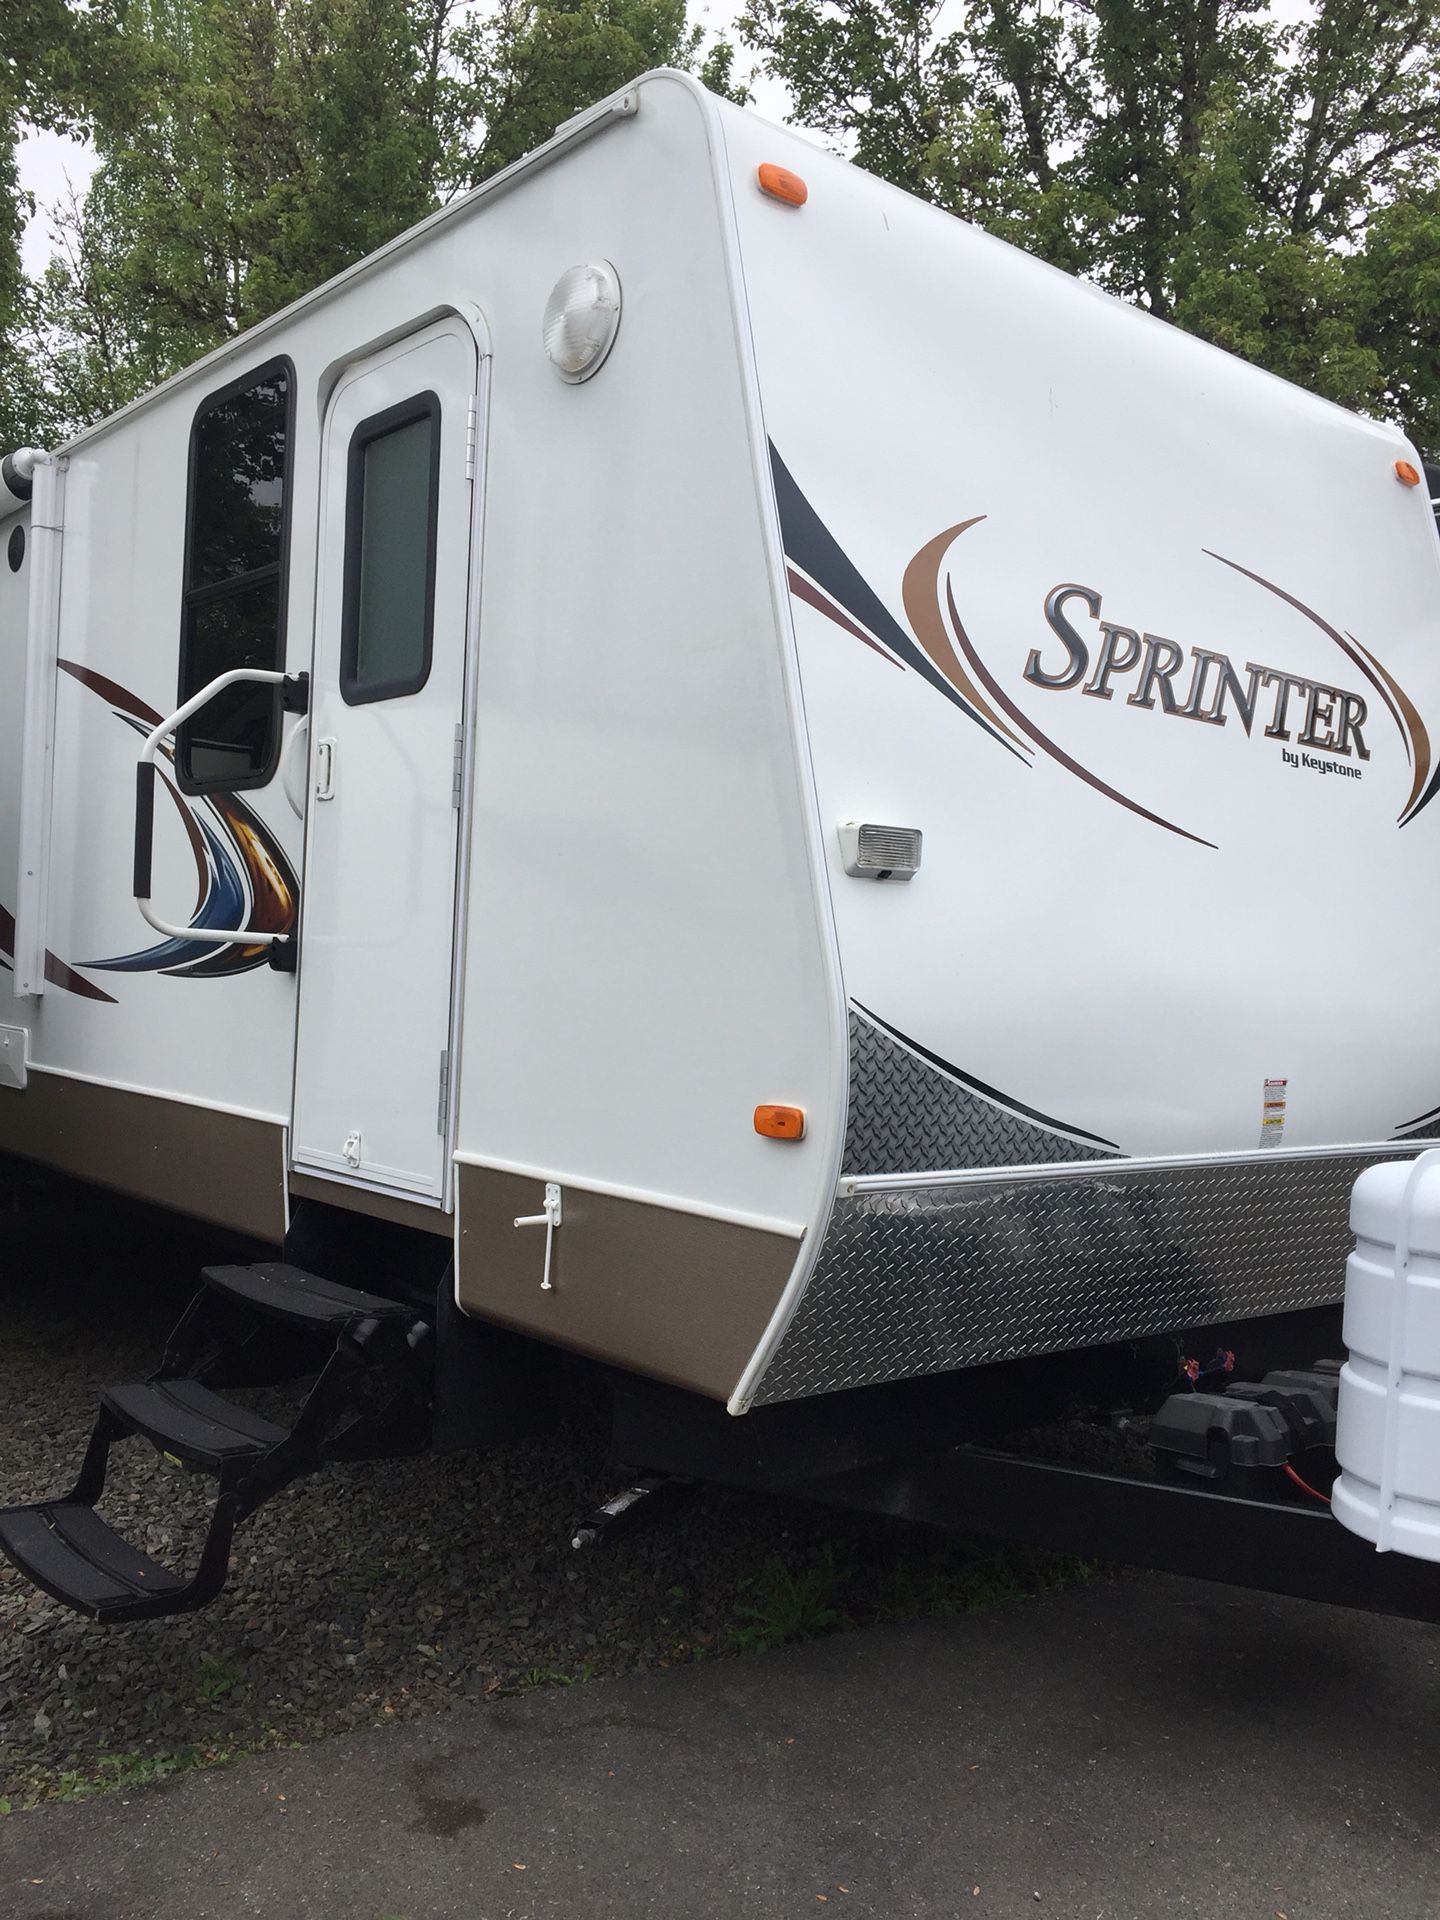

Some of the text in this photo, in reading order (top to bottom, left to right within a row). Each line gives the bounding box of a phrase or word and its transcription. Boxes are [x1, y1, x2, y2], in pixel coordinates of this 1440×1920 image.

[1023, 583, 1371, 761] SPRINTER
[1282, 748, 1362, 780] by Keystone
